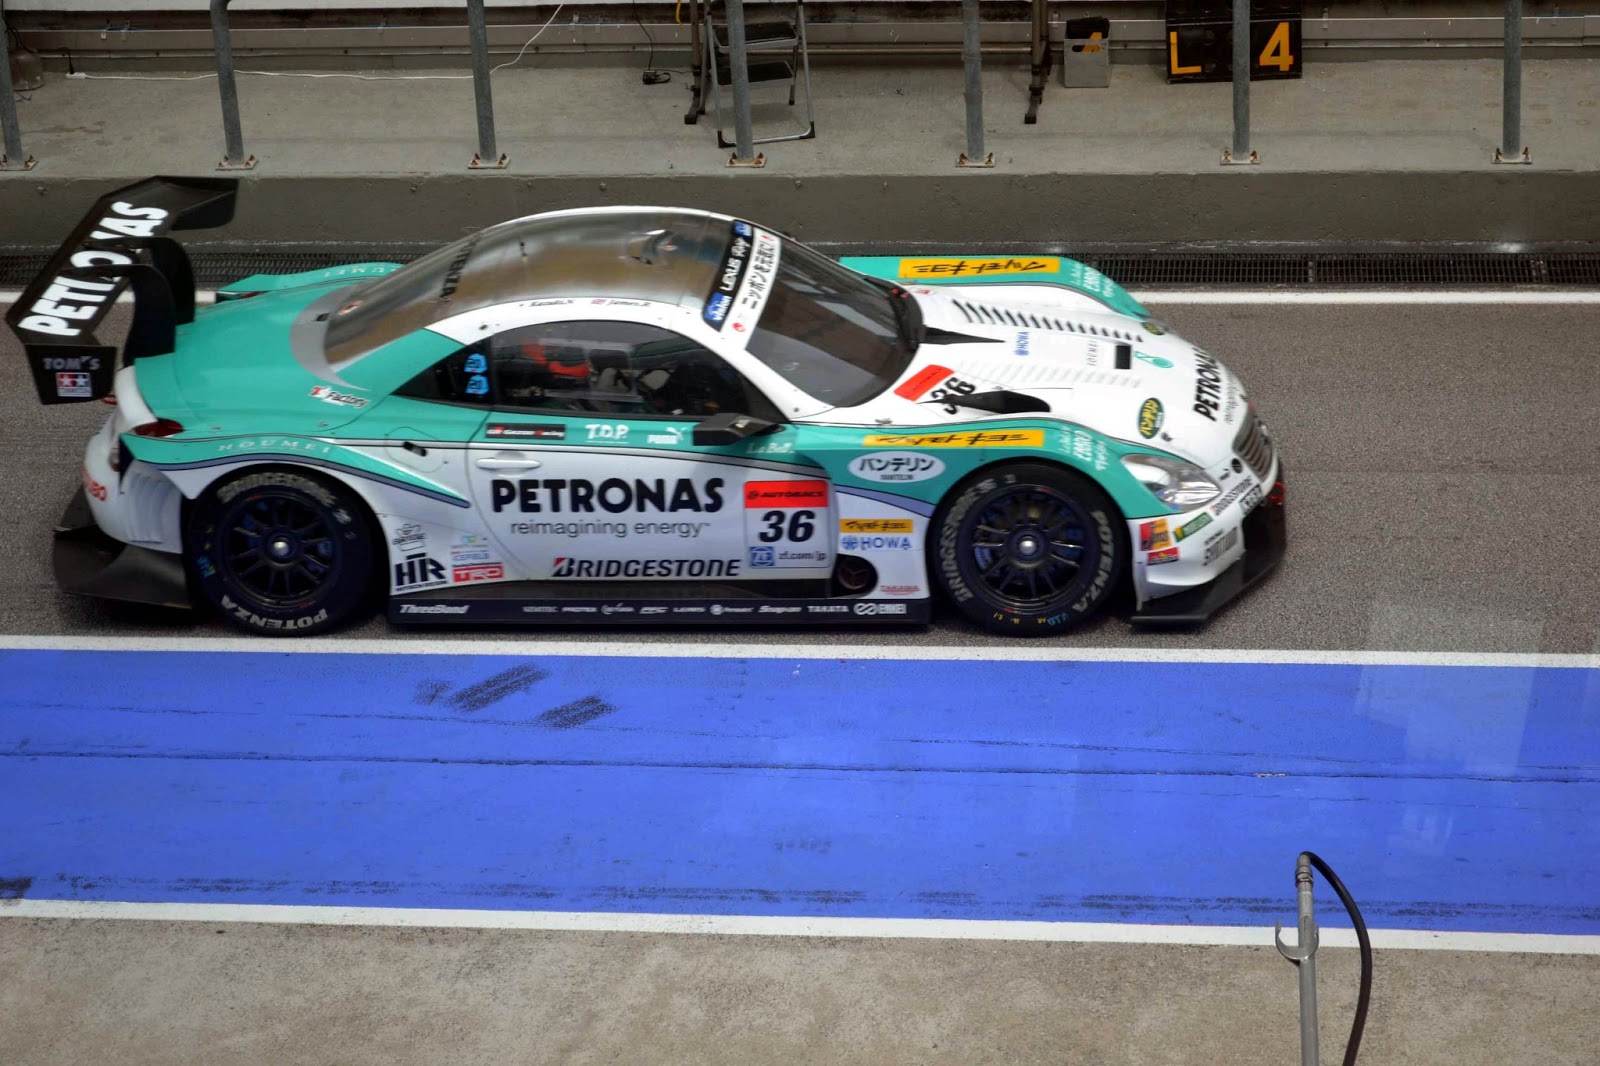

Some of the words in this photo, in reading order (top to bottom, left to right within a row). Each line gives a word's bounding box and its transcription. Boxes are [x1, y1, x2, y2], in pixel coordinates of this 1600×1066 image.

[1169, 31, 1202, 75] L
[1259, 21, 1294, 72] 4
[18, 201, 169, 336] PETOAS
[1193, 346, 1222, 421] PETRONA
[859, 457, 935, 472] バンテリン
[491, 477, 724, 513] PETRONAS
[510, 519, 628, 538] reimagining
[758, 510, 816, 543] 36
[861, 537, 912, 550] HOWA
[553, 557, 741, 578] BRIDGESTONE
[221, 594, 328, 630] POTENZA
